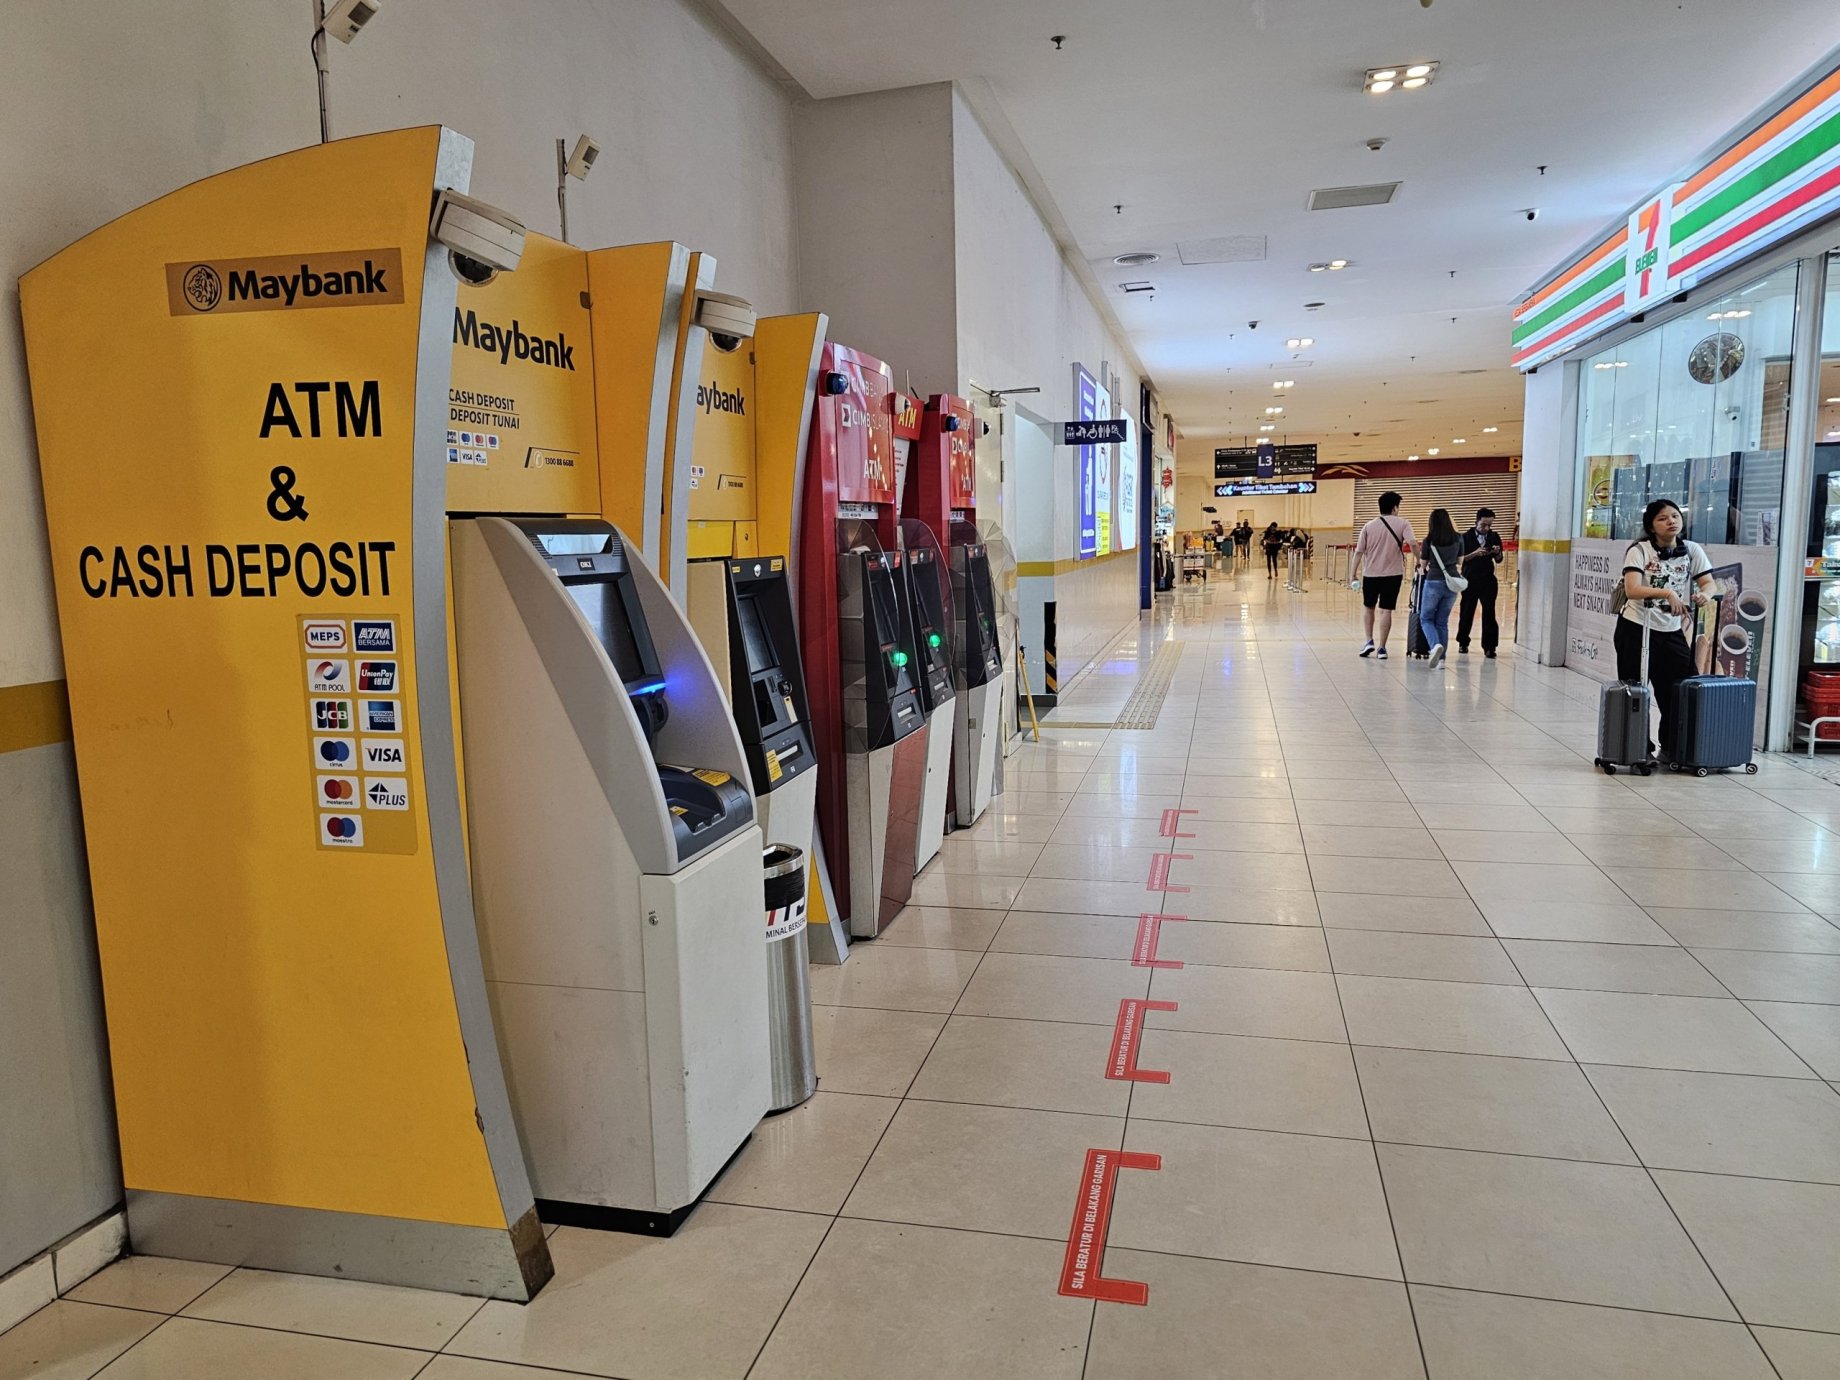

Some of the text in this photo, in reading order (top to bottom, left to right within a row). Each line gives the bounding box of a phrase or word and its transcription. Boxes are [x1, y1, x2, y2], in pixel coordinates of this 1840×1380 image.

[228, 260, 388, 306] Maybank
[453, 306, 575, 371] Maybank
[259, 380, 382, 438] ATM
[449, 388, 515, 411] CASH DEPOSIT
[697, 381, 745, 416] aybank
[450, 408, 520, 429] DEPOSIT TUNAI
[898, 407, 918, 430] ATM
[864, 459, 881, 480] ATM
[1258, 456, 1273, 467] L3
[267, 465, 310, 522] &
[79, 541, 396, 598] CASH DEPOSIT
[1575, 554, 1609, 574] HAPPINESS IS
[1574, 574, 1593, 592] ALWAYS
[1574, 592, 1586, 609] NEXT
[1587, 595, 1604, 614] SNACK
[310, 631, 340, 641] MEPS
[359, 628, 390, 639] ATM
[361, 669, 394, 678] UnionPay
[314, 683, 345, 692] ATM POOL
[317, 711, 348, 720] JCB
[365, 748, 402, 762] VISA
[378, 794, 406, 806] PLUS
[765, 927, 788, 939] MINAL
[1071, 1154, 1107, 1289] SILA BERATUR DI BELAKANG GARISAN
